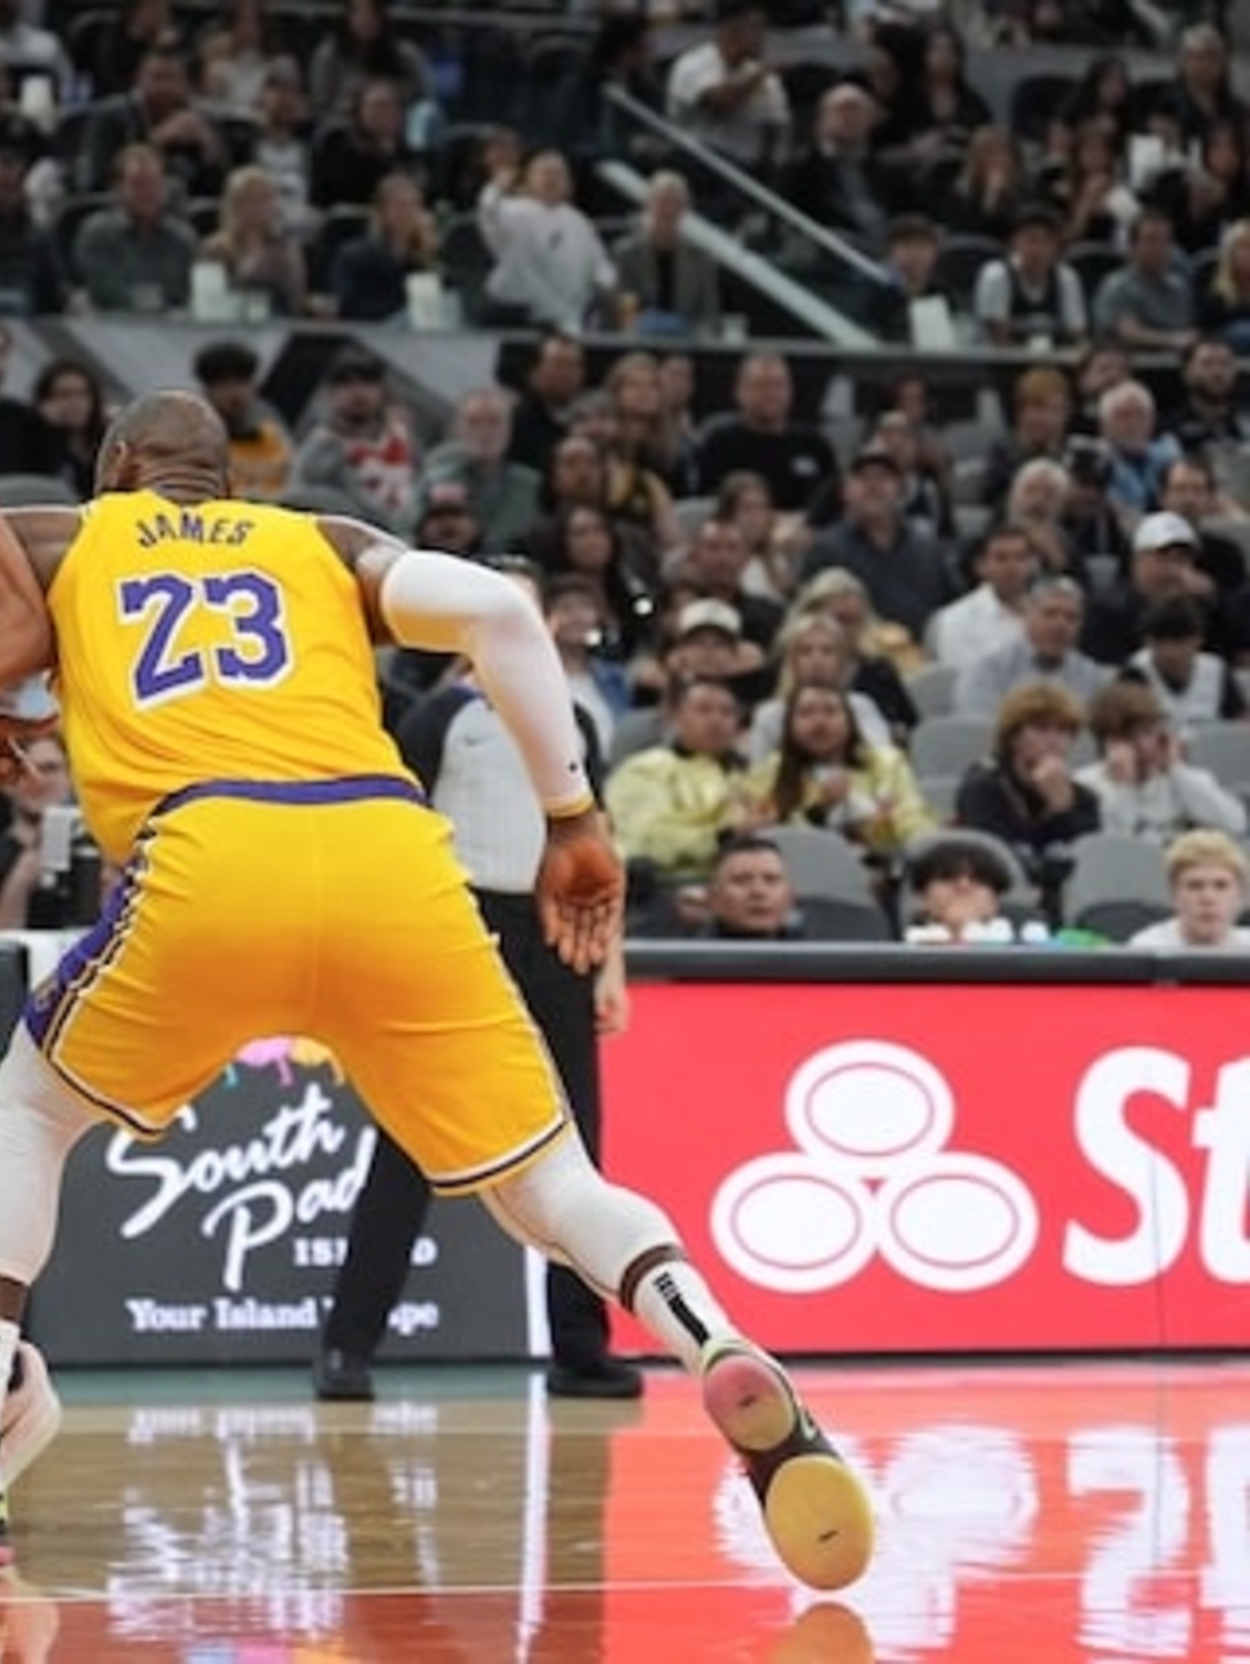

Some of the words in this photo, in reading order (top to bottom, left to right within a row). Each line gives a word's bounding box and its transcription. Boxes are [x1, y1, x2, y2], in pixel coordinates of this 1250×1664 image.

[136, 512, 253, 548] JAMES
[116, 569, 293, 708] 23
[105, 1081, 346, 1238] South
[201, 1125, 376, 1291] Pad
[124, 1297, 207, 1330] Your
[214, 1297, 319, 1330] Island
